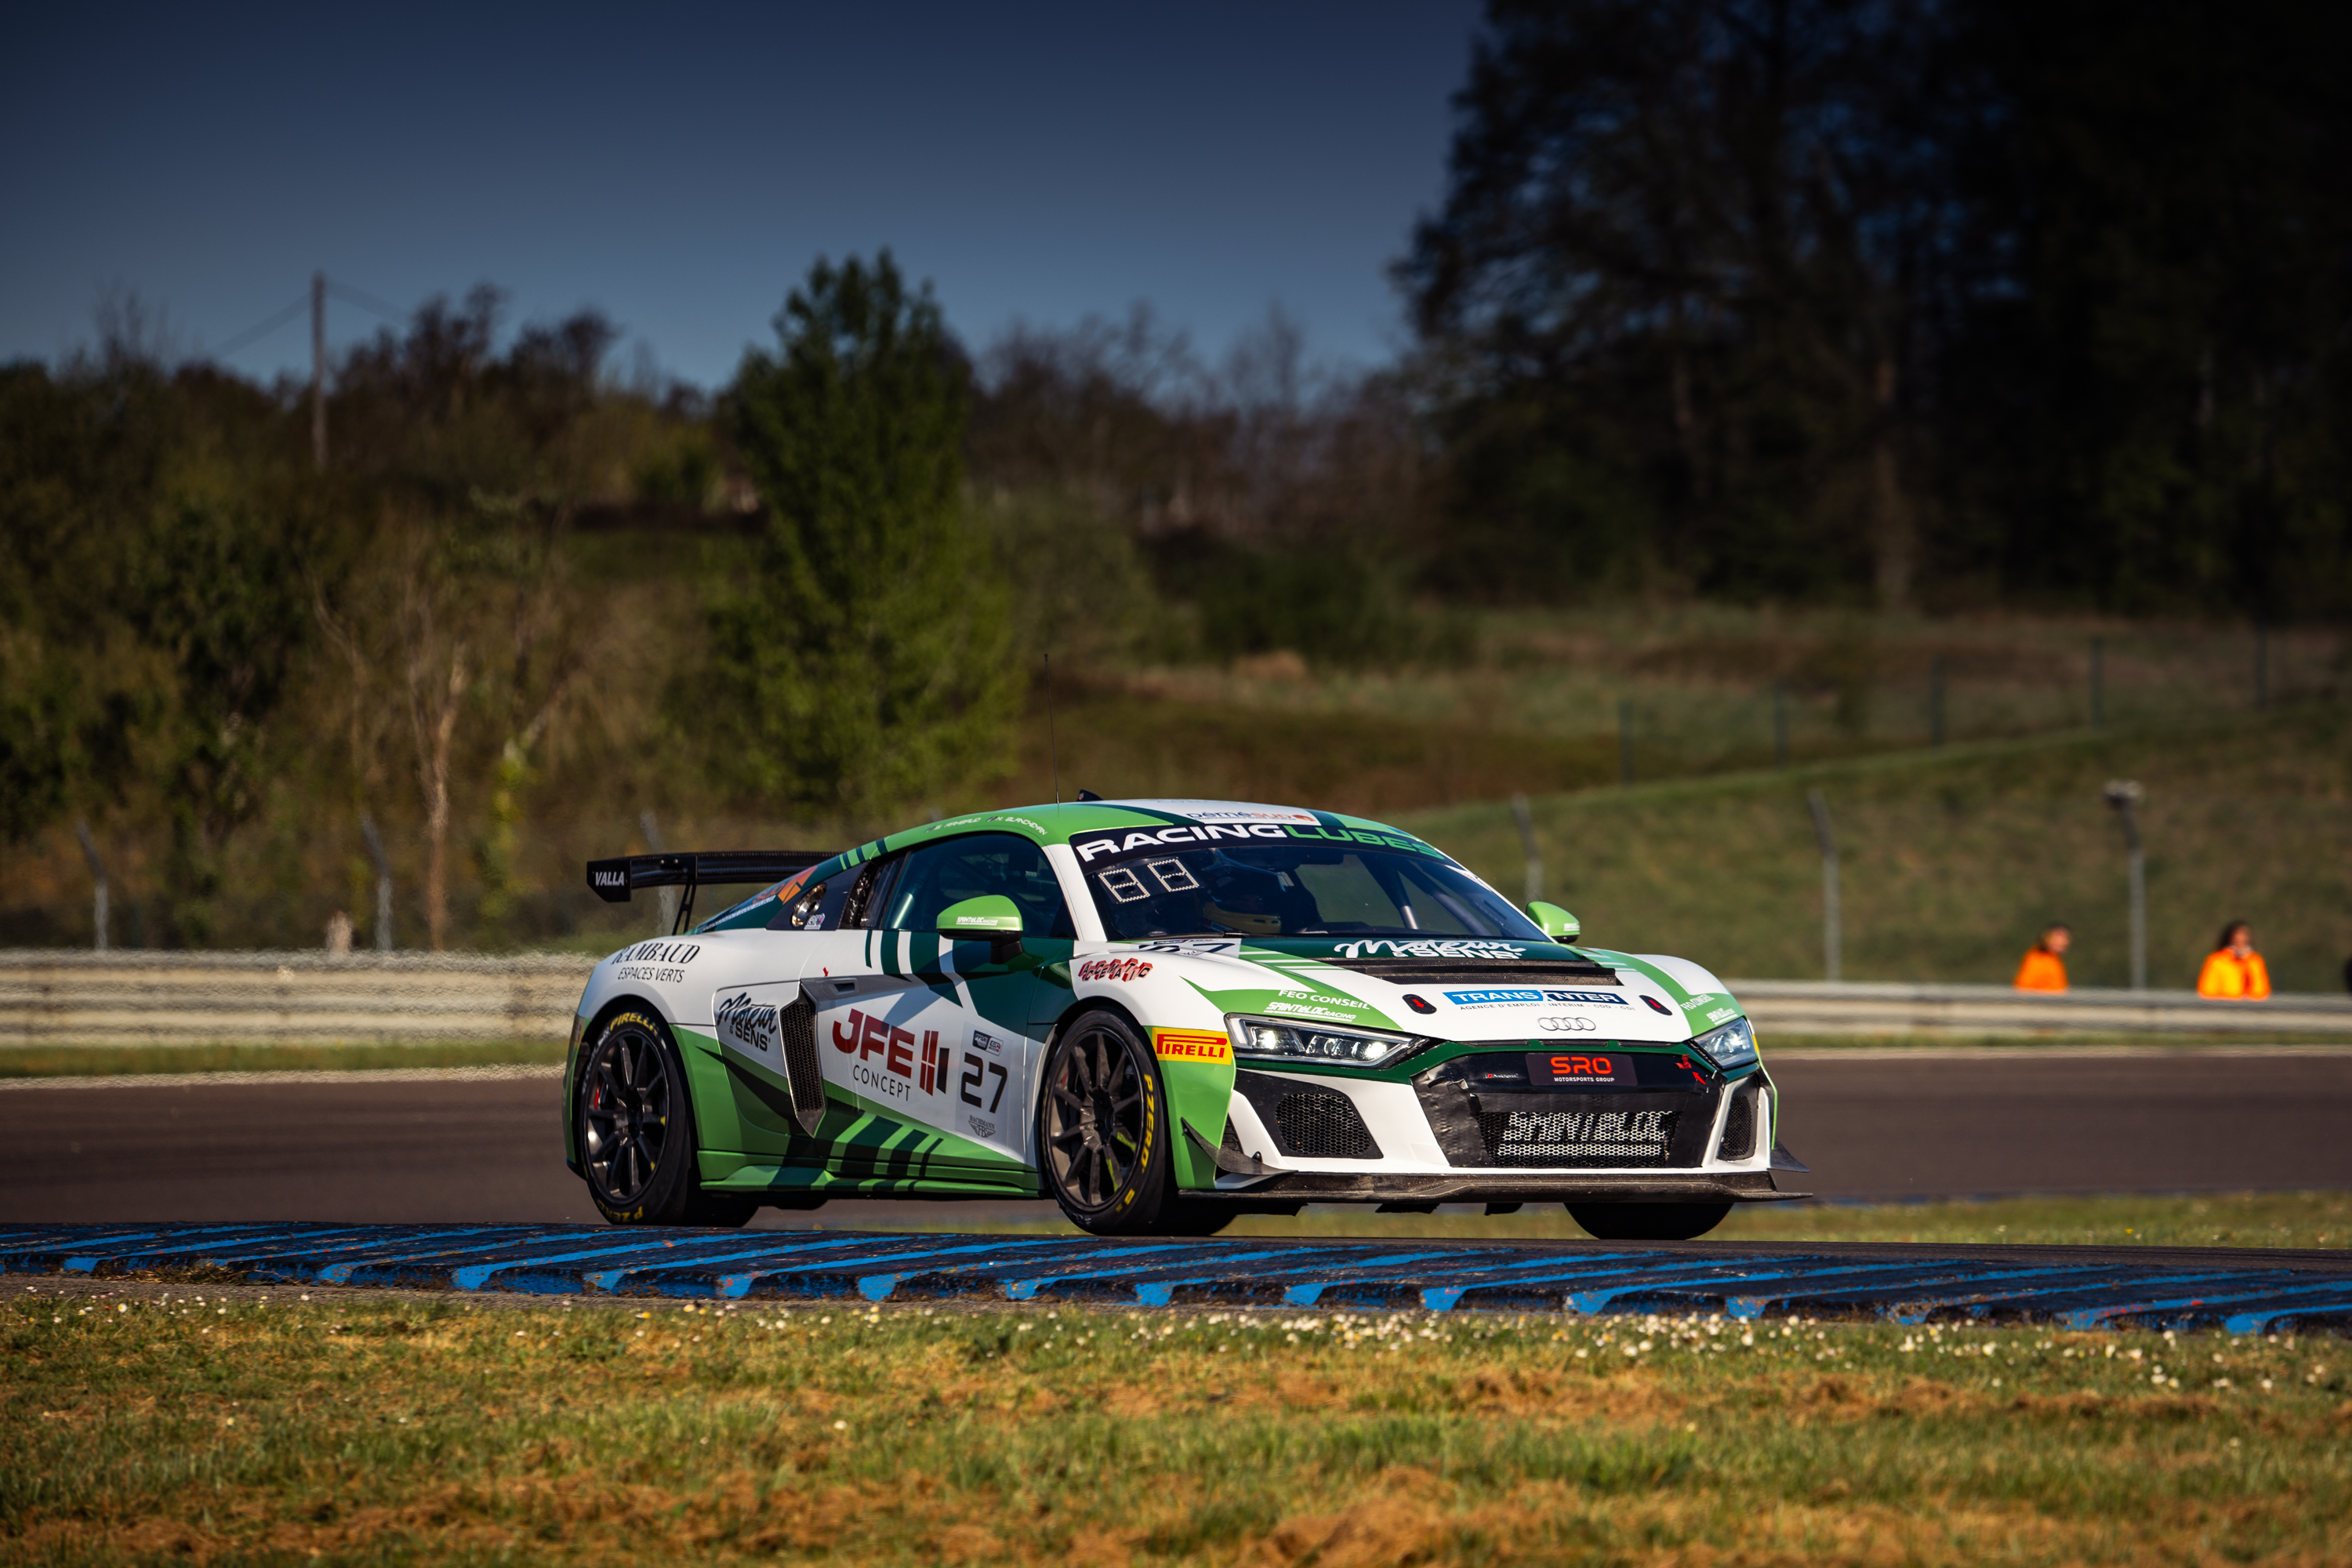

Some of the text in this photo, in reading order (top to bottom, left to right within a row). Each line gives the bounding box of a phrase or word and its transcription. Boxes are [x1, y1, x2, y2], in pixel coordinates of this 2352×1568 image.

[595, 871, 625, 887] VALLA
[611, 942, 701, 965] RAMBAUD
[1407, 948, 1520, 960] SENS
[618, 967, 685, 983] ESPACES VERTS
[1278, 989, 1370, 1011] FEO CONSEIL
[1452, 991, 1541, 1002] TRANS
[735, 1021, 768, 1052] SENS
[832, 1008, 916, 1079] JFE
[1156, 1033, 1228, 1058] PIRELLI
[1550, 1056, 1612, 1074] SRO
[852, 1065, 911, 1102] CONCEPT
[960, 1051, 1008, 1114] 27
